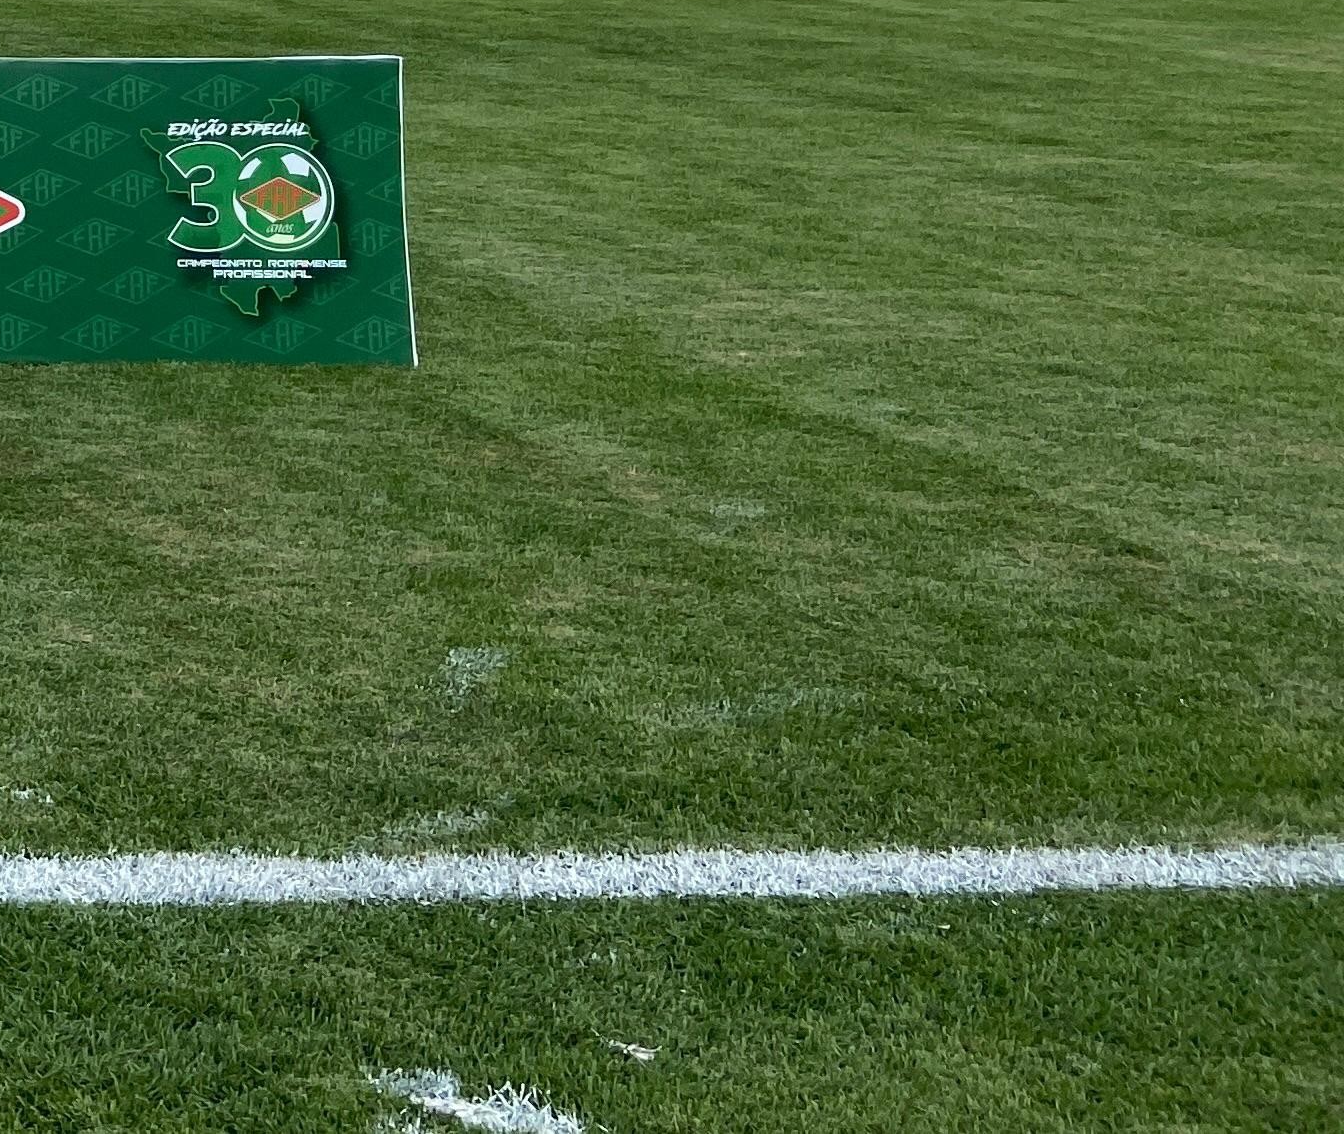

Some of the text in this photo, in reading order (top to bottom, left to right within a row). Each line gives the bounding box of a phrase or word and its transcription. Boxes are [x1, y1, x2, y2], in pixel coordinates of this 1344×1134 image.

[165, 141, 335, 253] 30
[265, 223, 295, 234] anos
[176, 258, 348, 268] CAMPEONATO RORAIMENSE
[212, 269, 313, 279] PROFISSIONAL
